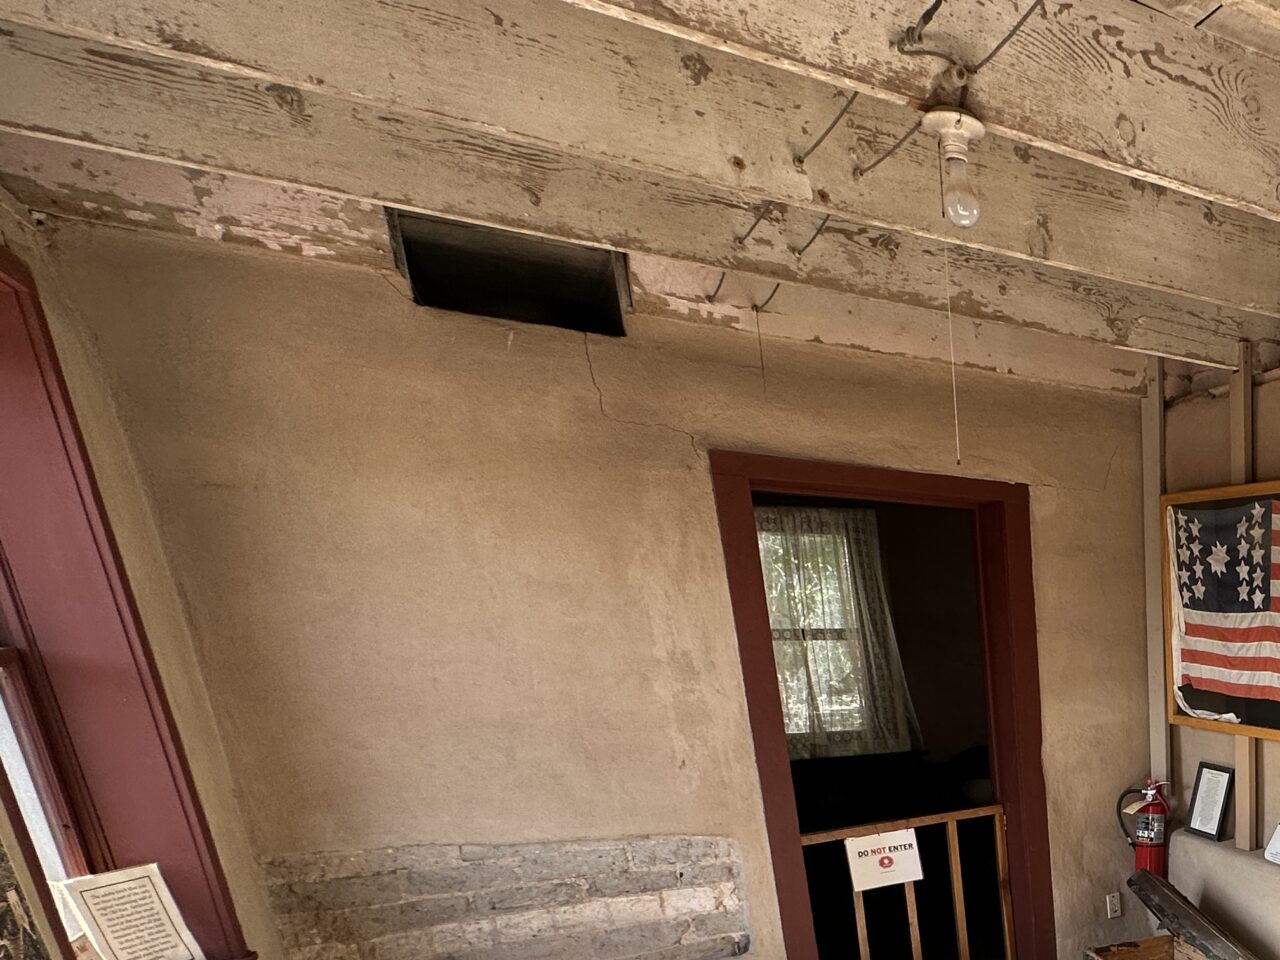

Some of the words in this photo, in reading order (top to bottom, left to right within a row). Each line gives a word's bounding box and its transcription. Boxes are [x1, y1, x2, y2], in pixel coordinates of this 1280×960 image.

[858, 850, 868, 858] DO
[870, 847, 886, 856] NOT
[889, 843, 914, 852] ENTER
